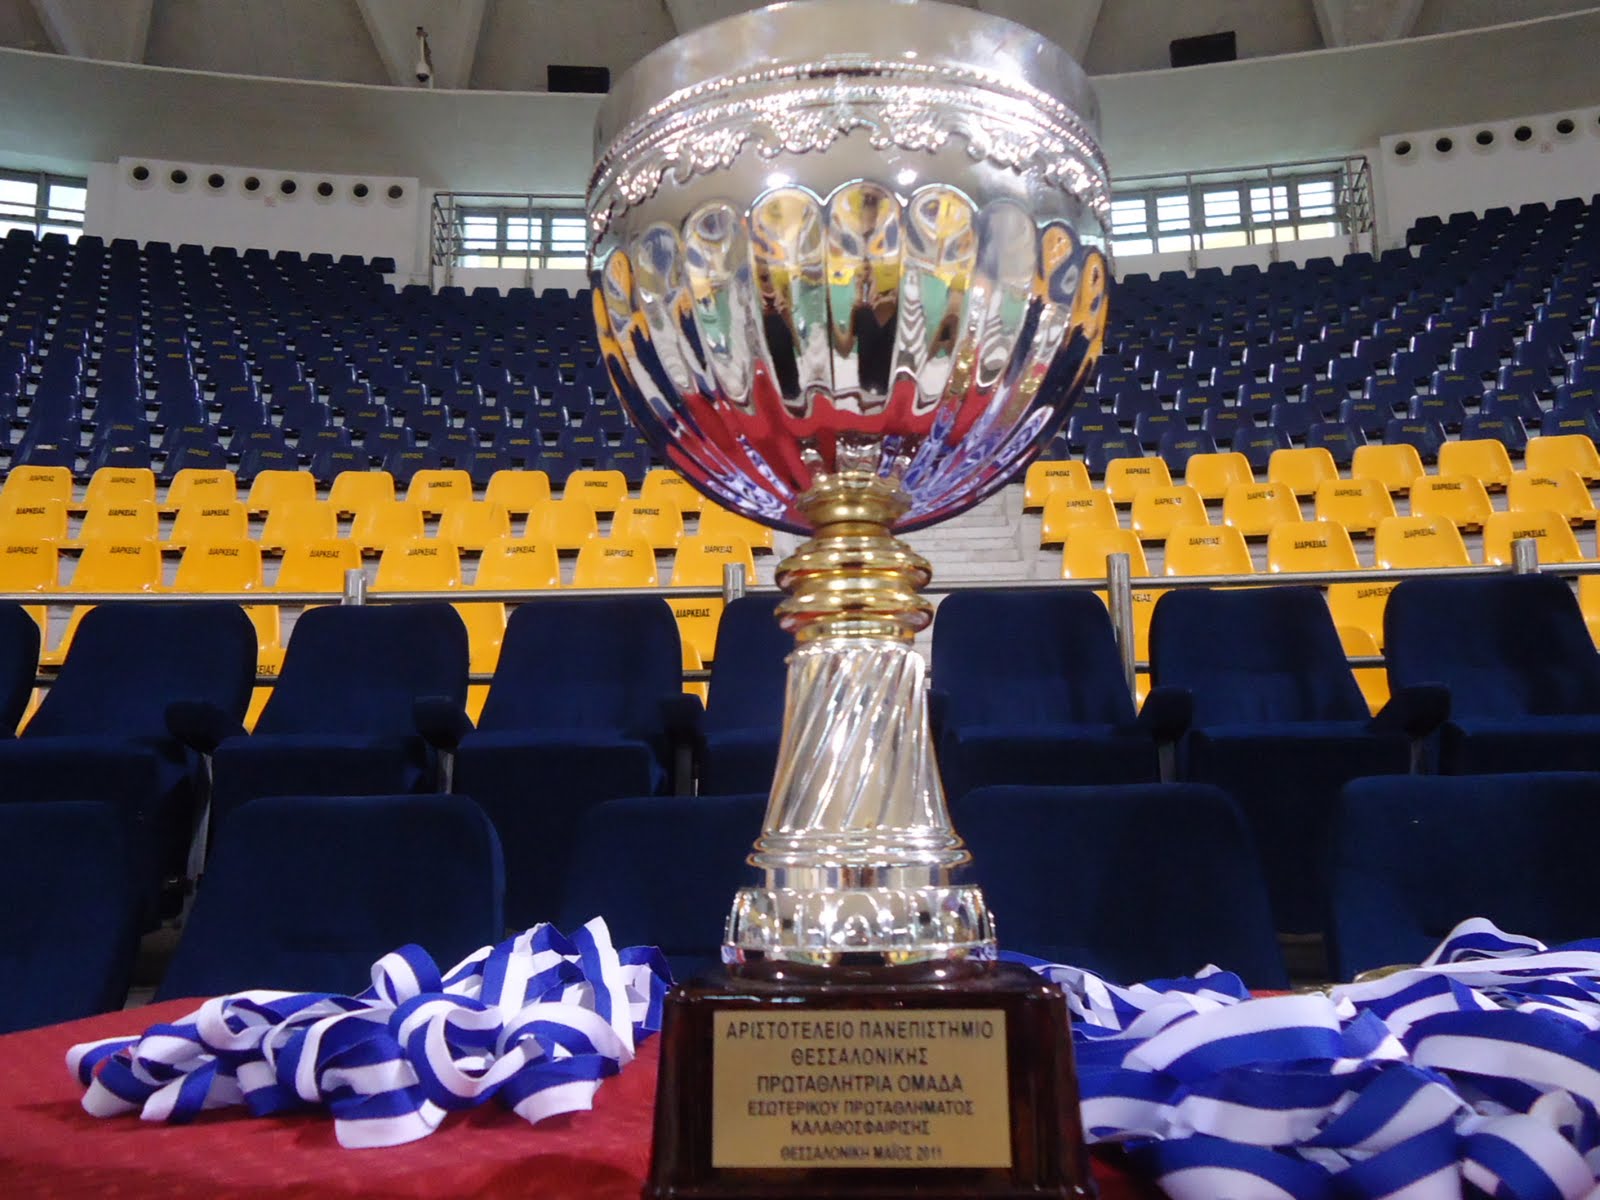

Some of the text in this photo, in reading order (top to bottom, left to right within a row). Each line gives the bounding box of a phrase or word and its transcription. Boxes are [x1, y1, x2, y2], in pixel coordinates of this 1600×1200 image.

[505, 545, 536, 554] ΔΙΑΡΚΕΙΑΣ
[703, 545, 733, 554] ΔΙΑΡΚΕΙΑΣ
[1295, 539, 1328, 550] ΔΙΑΡΚΕΙΑΣ
[7, 546, 39, 555] ΔΙΑΡΚΕΙΑΣ
[110, 546, 142, 555] ΔΙΑΡΚΕΙΑΣ
[208, 547, 239, 557] ΔΙΑΡΚΕΙΑΣ
[310, 549, 340, 559] ΔΙΑΡΚΕΙΑΣ
[408, 547, 438, 557] ΔΙΑΡΚΕΙΑΣ
[676, 608, 711, 619] ΔΙΑΡΚΕΙΑΣ
[726, 1020, 994, 1040] ΑΡΙΣΤΟΤΕΛΕΙΟ ΠΑΝΕΠΙΣΤΗΜΙΟ
[791, 1047, 929, 1066] ΘΕΣΣΑΛΟΝΙΚΗΣ
[757, 1074, 962, 1094] ΠΡΩΤΑΘΛΗΤΡΙΑ ΟΜΑΔΑ
[747, 1100, 975, 1116] ΕΣΩΤΕΡΙΚΟΥ ΠΡΩΤΑΘΛΗΜΑΤΟΣ
[791, 1119, 931, 1136] ΚΑΛΑΘΟΣΦΑΙΡΙΣΗΣ
[780, 1145, 870, 1161] ΘΕΣΣΑΛΟΝΙΚΗ
[916, 1145, 942, 1160] 2011
